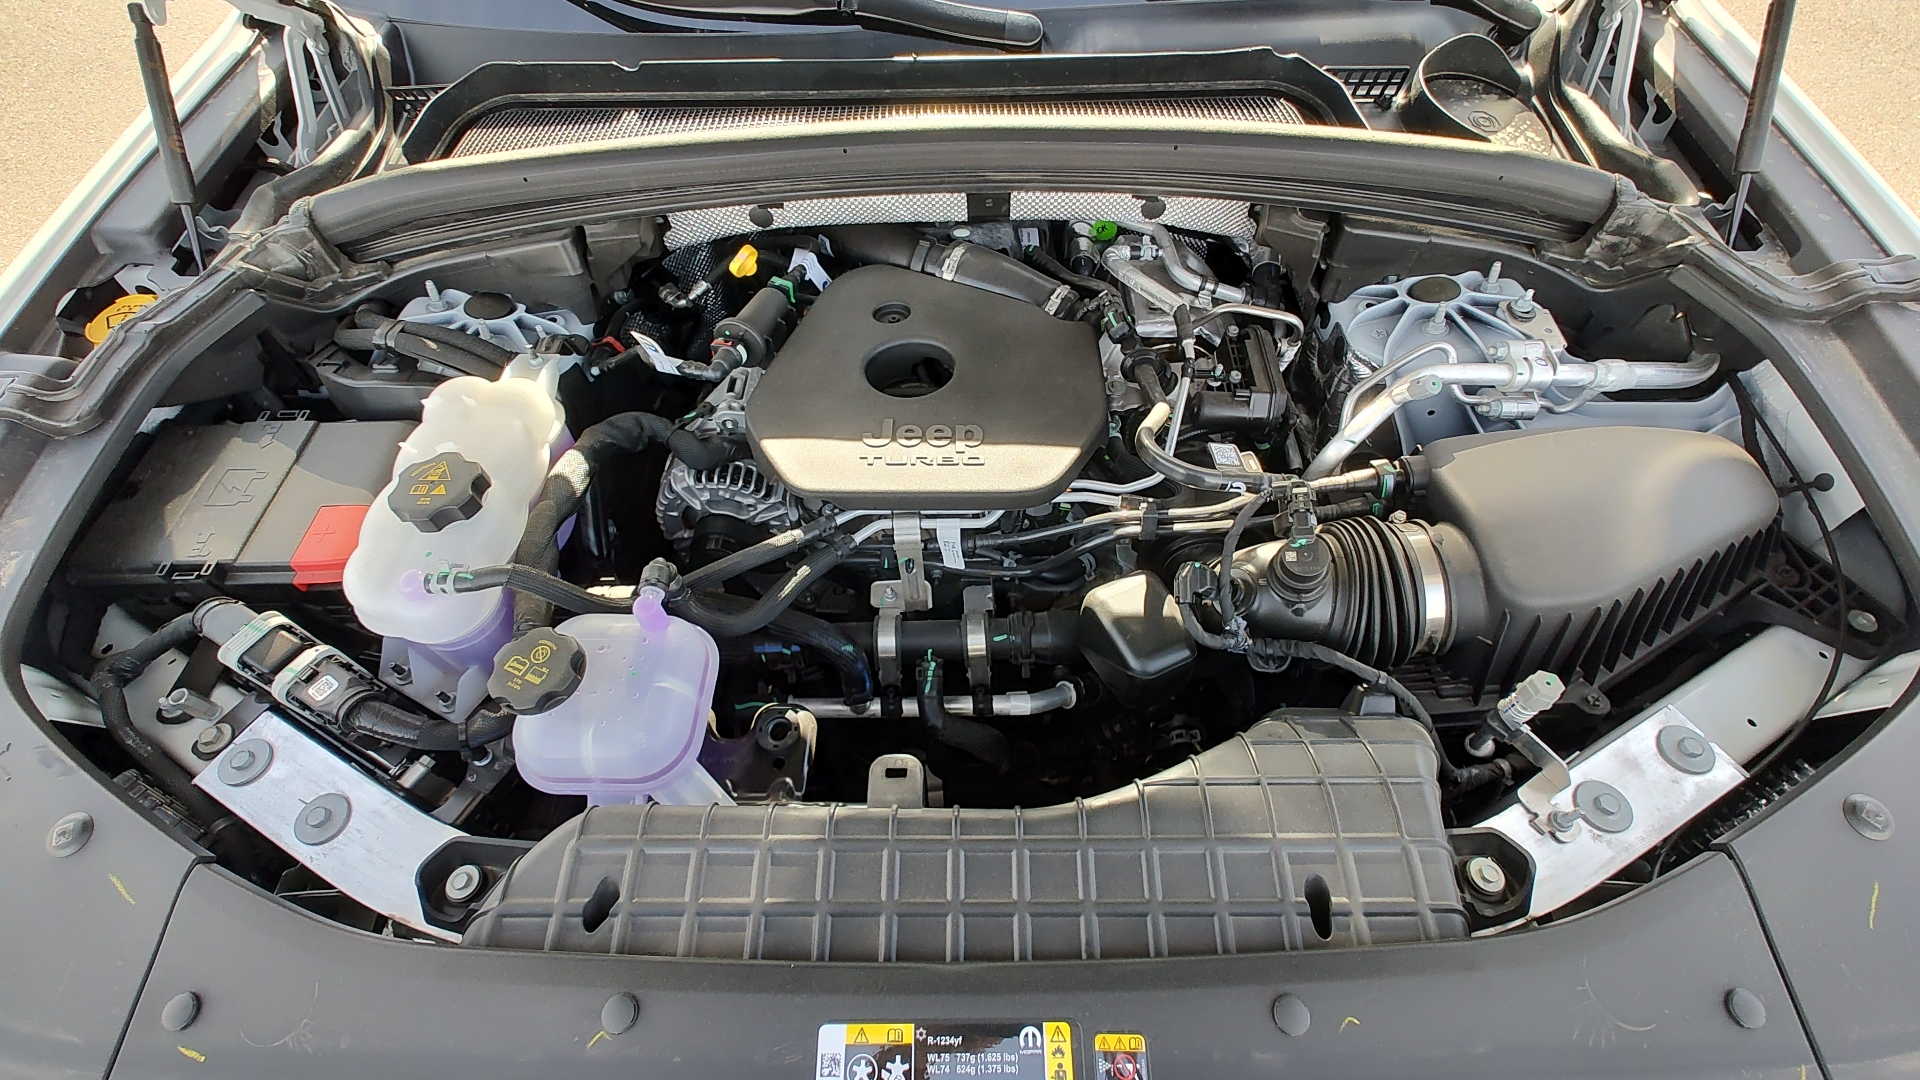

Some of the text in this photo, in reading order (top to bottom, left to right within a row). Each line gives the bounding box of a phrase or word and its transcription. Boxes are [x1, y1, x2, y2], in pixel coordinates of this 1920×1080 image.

[1097, 224, 1109, 235] OK
[862, 418, 984, 454] Jeep
[859, 455, 985, 466] TURBO
[927, 1035, 963, 1047] R-1234yf
[927, 1053, 1019, 1064] WL75 737g (1.625 lbs)
[927, 1064, 1019, 1075] WL74 624g (1.375 lbs)
